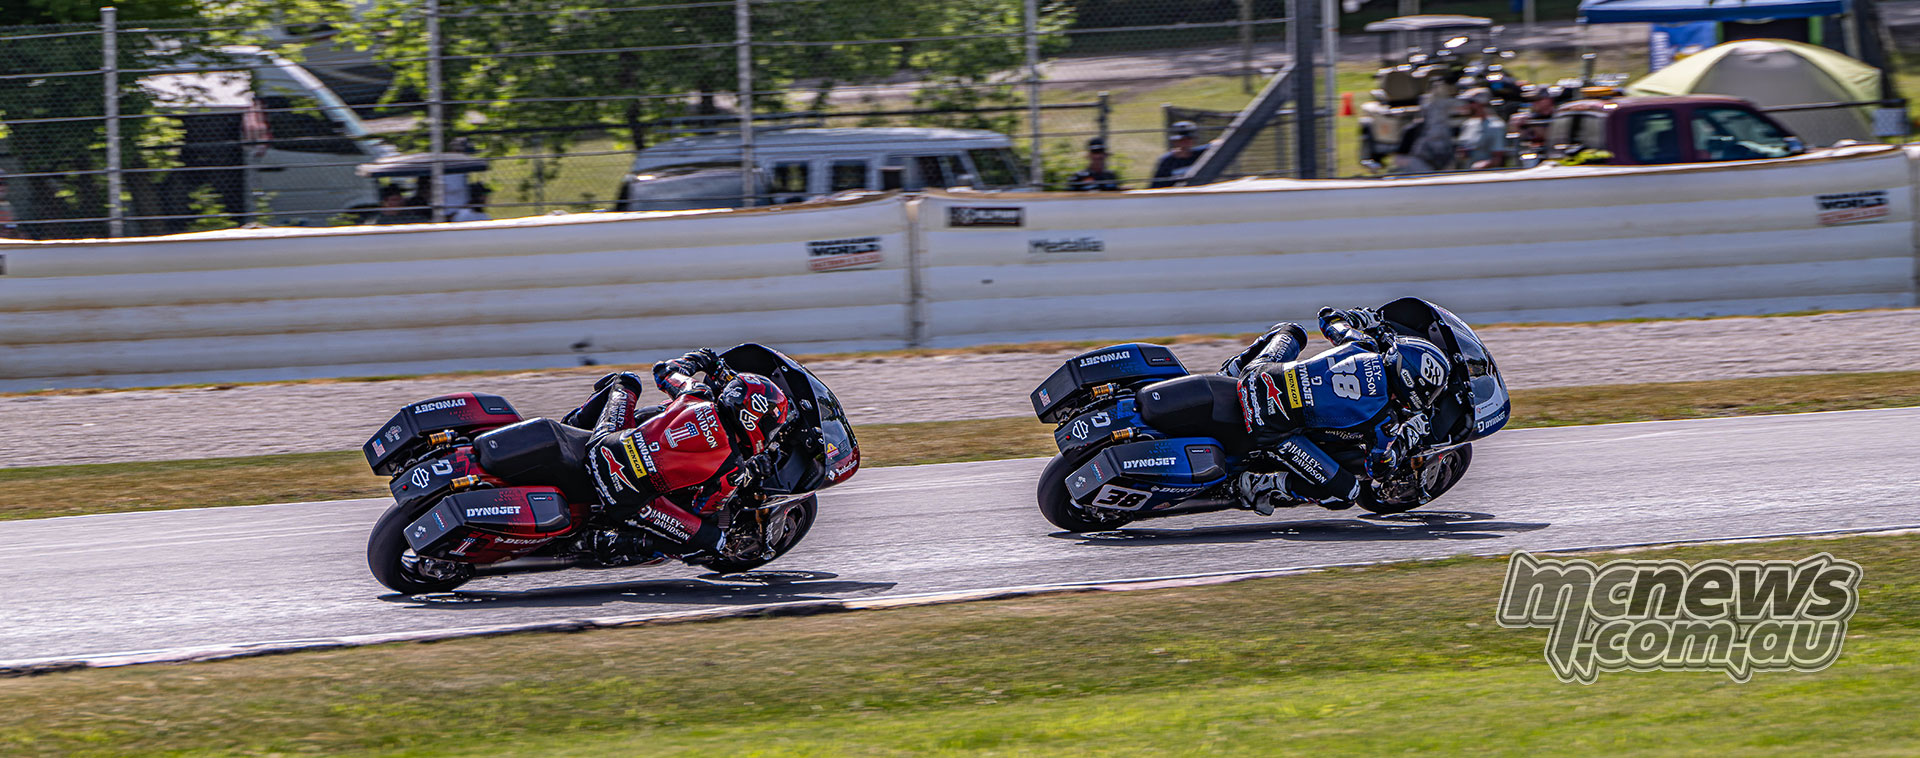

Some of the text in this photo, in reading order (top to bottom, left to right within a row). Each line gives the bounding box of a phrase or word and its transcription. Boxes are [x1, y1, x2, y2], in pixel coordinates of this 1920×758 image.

[1080, 351, 1130, 367] DYNOJET
[1287, 372, 1299, 405] DUNLOP
[415, 398, 467, 414] DYNOJET
[627, 441, 643, 475] DUNLOP
[634, 431, 657, 473] DYNOJET
[1124, 457, 1176, 469] DYNOJET
[1287, 443, 1323, 470] HARLEY-
[1291, 456, 1327, 484] DAVIDSON
[1097, 488, 1147, 508] 38
[466, 505, 521, 517] DYNOJET
[650, 508, 685, 530] HARLEY-
[653, 518, 691, 541] DAVIDSON
